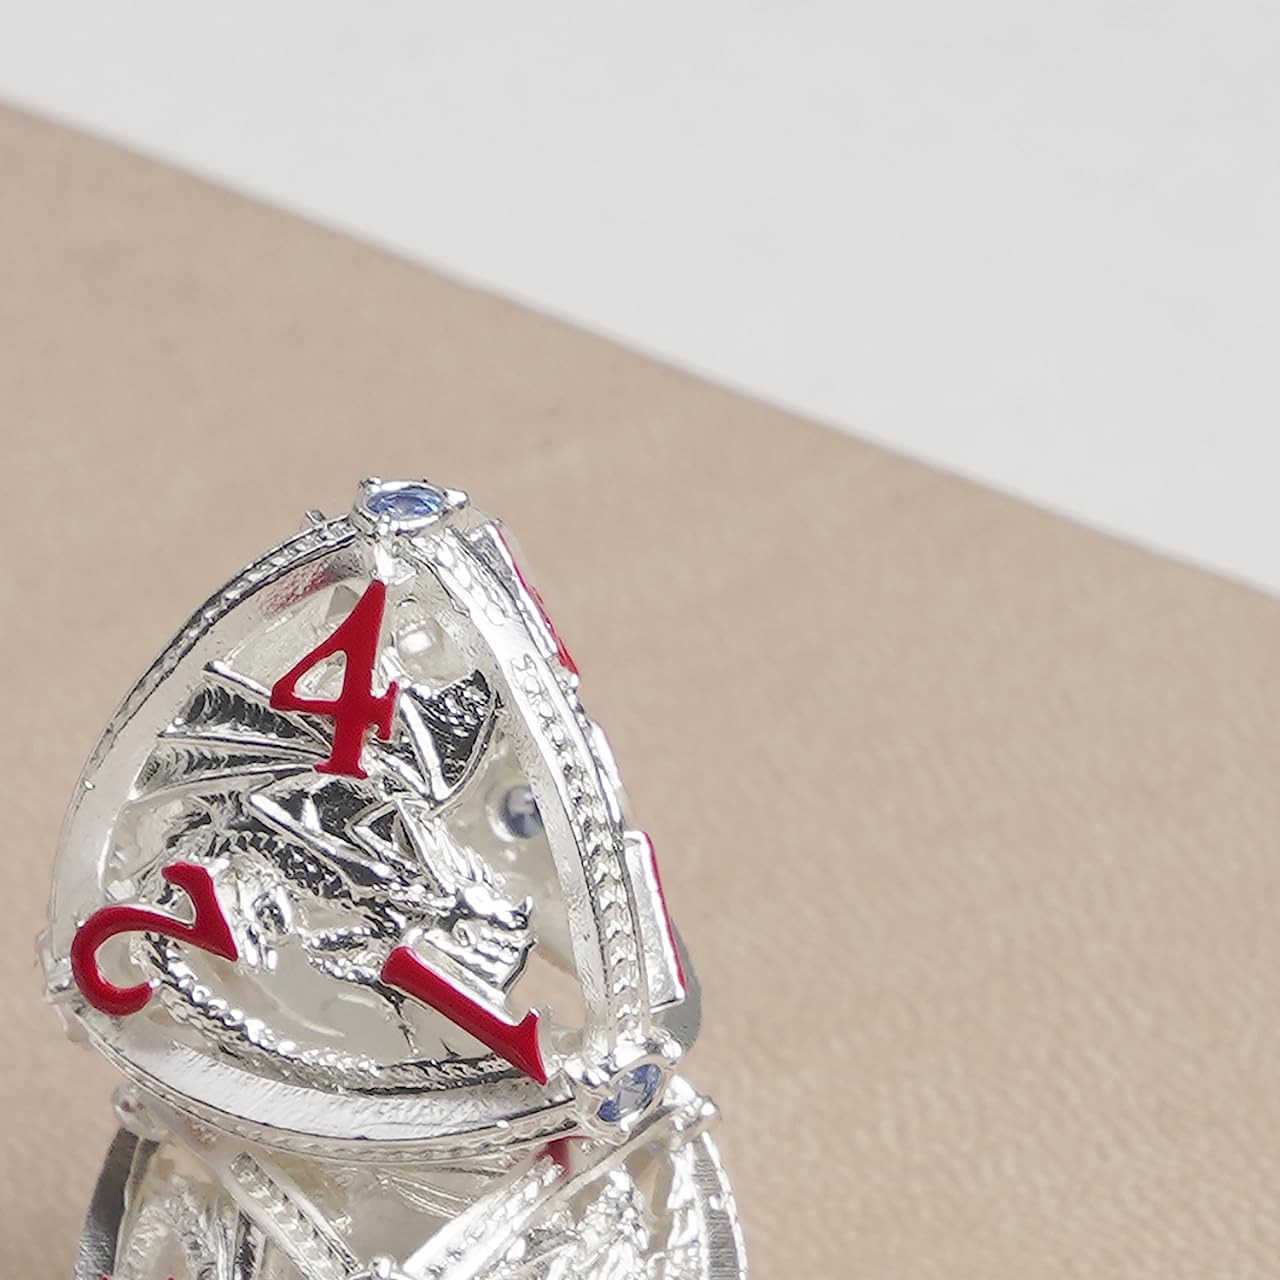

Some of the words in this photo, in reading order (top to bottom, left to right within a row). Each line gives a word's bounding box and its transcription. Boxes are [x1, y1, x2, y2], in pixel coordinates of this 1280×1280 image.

[270, 580, 398, 779] 4
[72, 861, 238, 1016] 2
[382, 946, 547, 1085] 1
